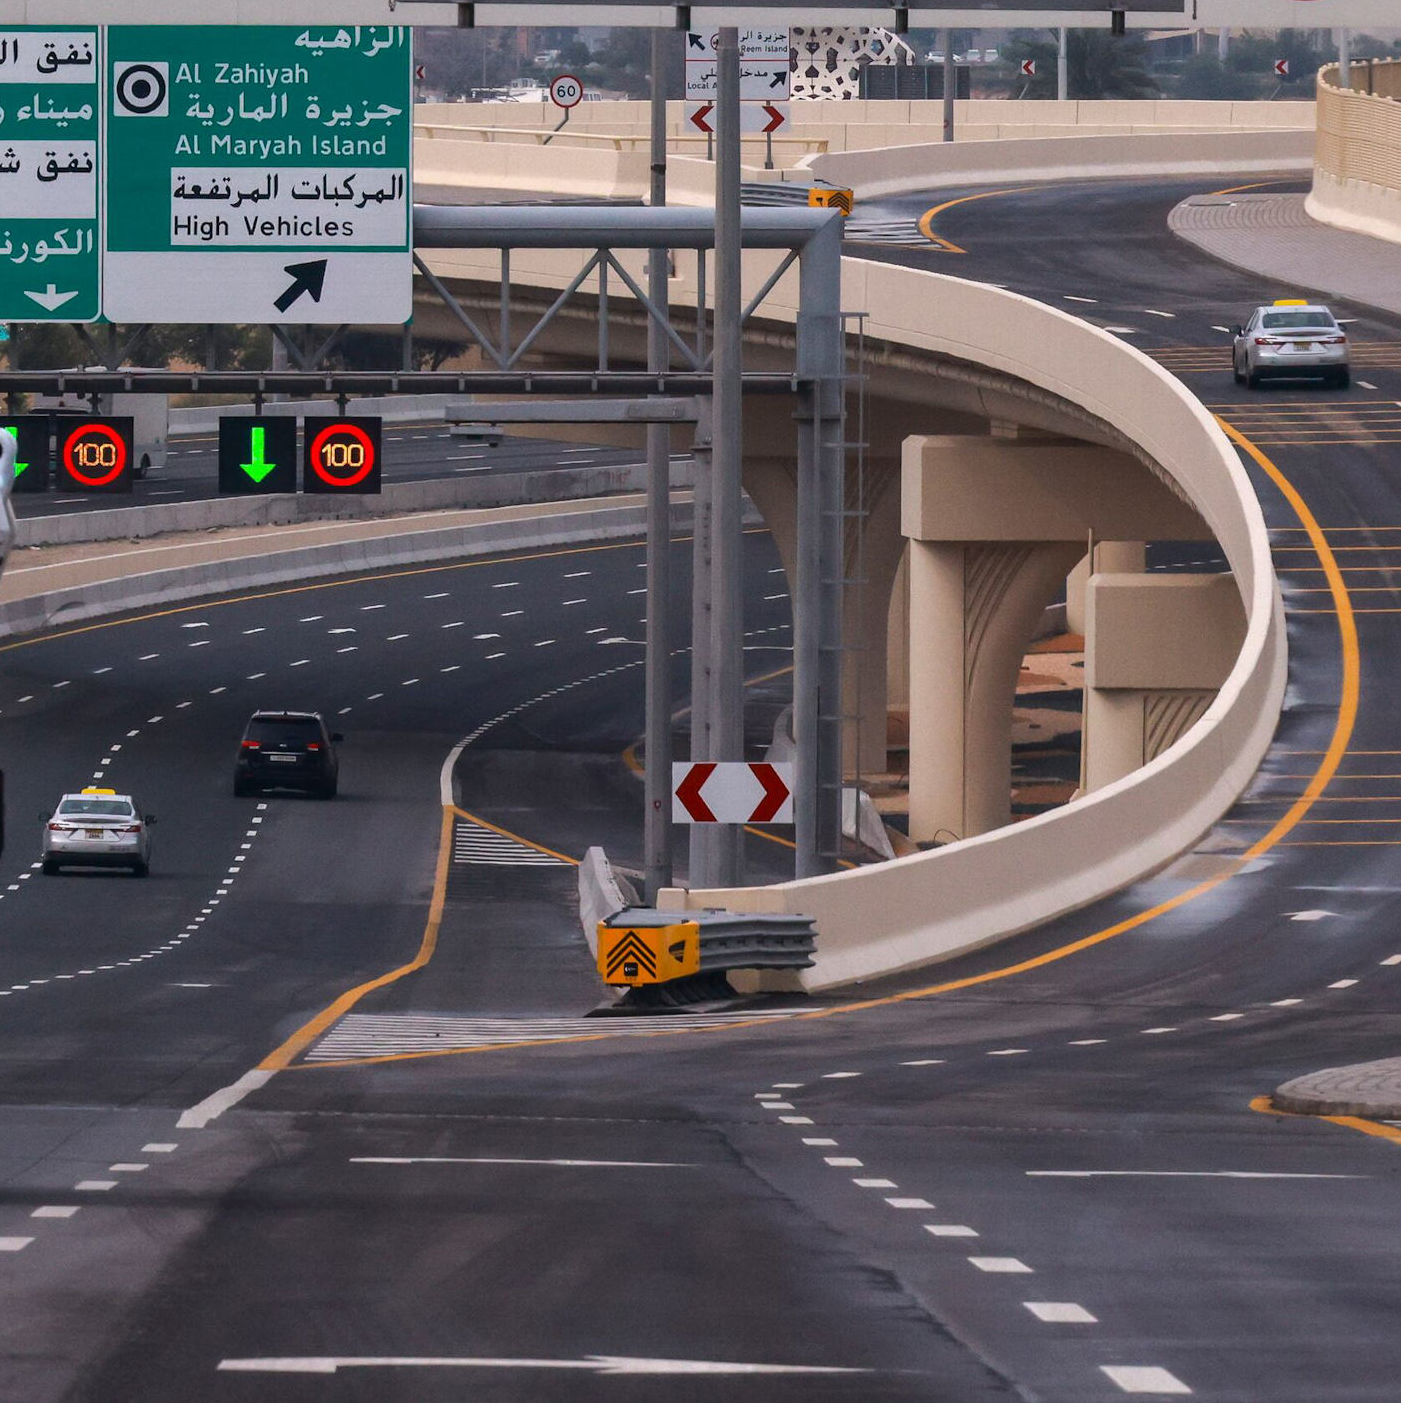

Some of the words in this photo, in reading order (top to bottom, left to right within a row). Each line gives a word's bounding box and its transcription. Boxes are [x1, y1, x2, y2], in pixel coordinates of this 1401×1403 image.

[36, 42, 93, 74] نفق
[765, 44, 788, 53] Island
[175, 63, 201, 84] Al
[214, 63, 309, 88] Zahiyah
[557, 85, 576, 98] 60
[17, 92, 93, 127] ميناء
[186, 92, 288, 127] المارية
[306, 95, 402, 127] جزيرة
[175, 135, 200, 155] Al
[211, 135, 301, 159] Maryah
[313, 135, 386, 156] Island
[36, 150, 93, 182] نفق
[173, 173, 279, 208] المرتفعة
[291, 173, 404, 208] المركبات
[174, 216, 229, 240] High
[244, 216, 354, 237] Vehicles
[73, 443, 116, 467] 100
[322, 443, 365, 467] 100
